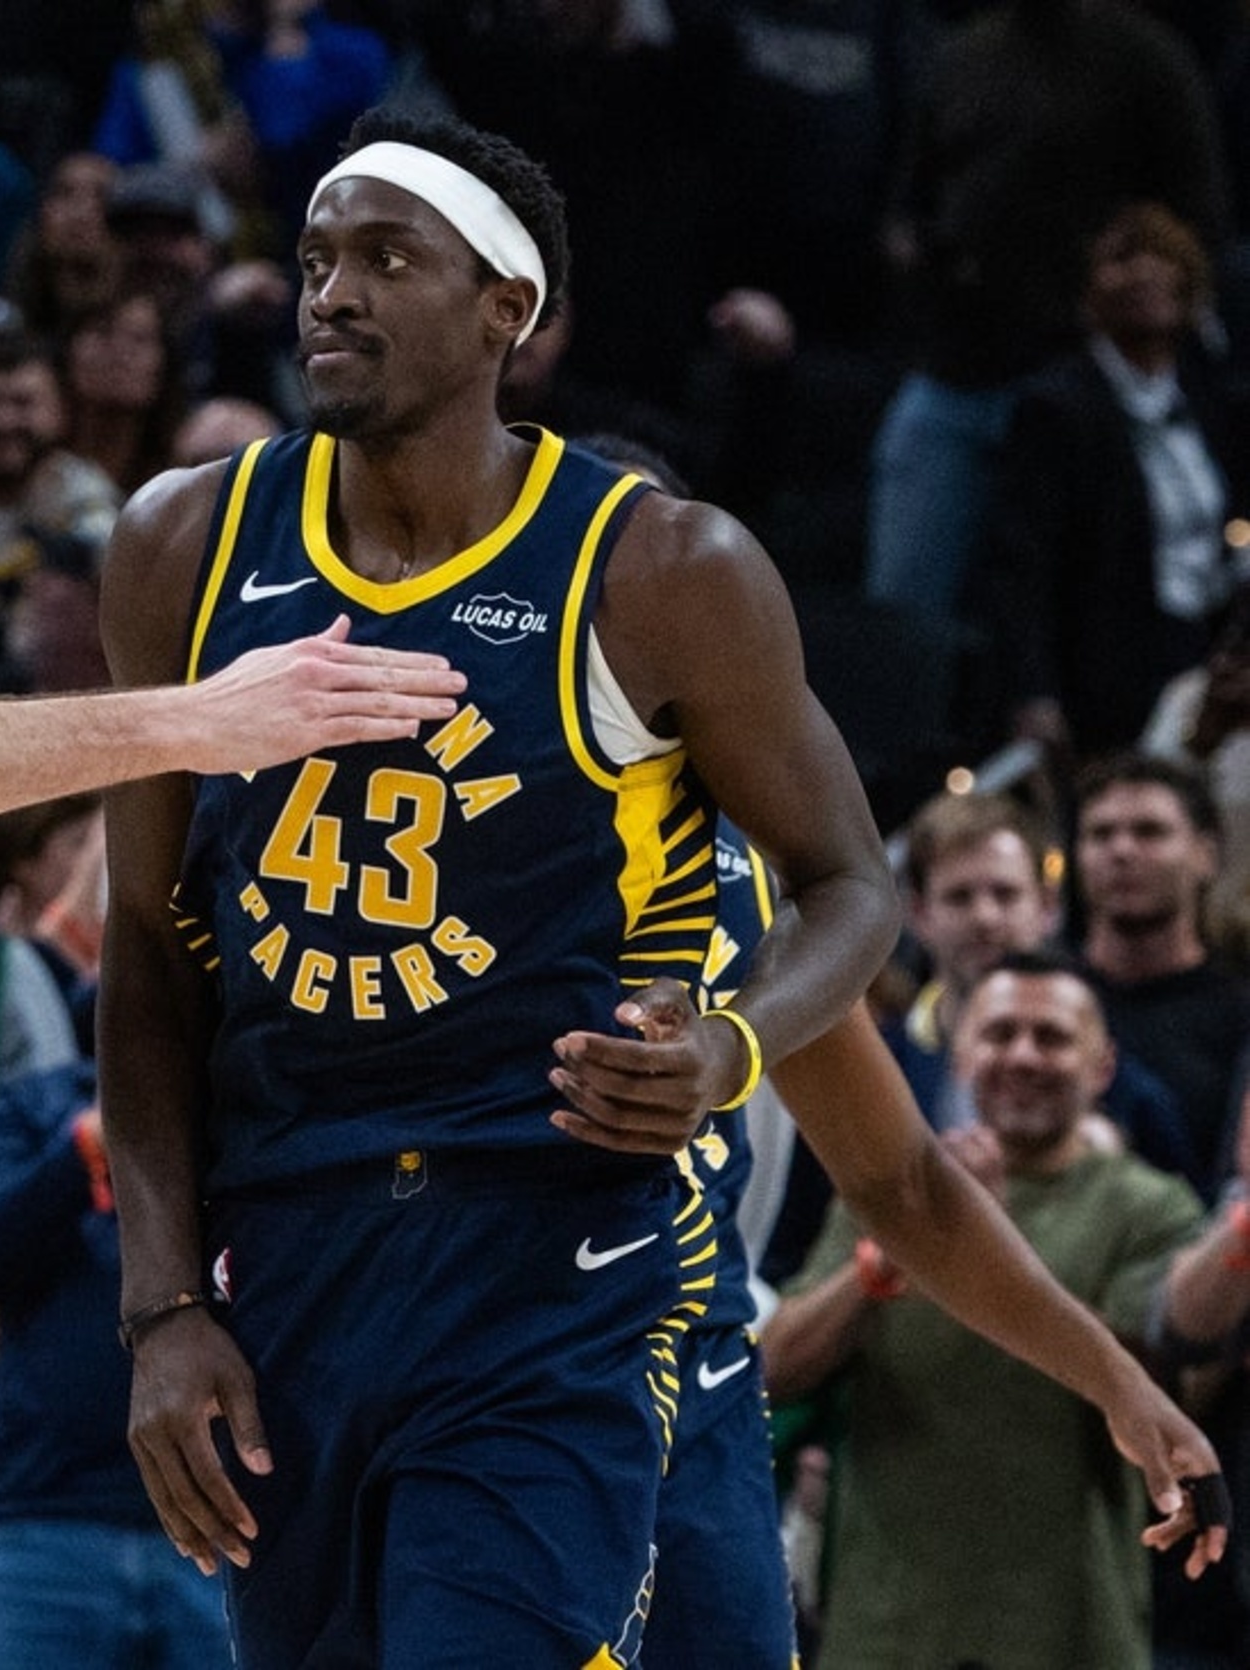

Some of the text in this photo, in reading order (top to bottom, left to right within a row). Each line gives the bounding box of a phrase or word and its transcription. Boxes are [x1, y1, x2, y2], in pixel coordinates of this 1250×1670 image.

[451, 602, 548, 633] LUCAS OIL
[259, 757, 447, 930] 43
[239, 881, 497, 1020] PACERS
